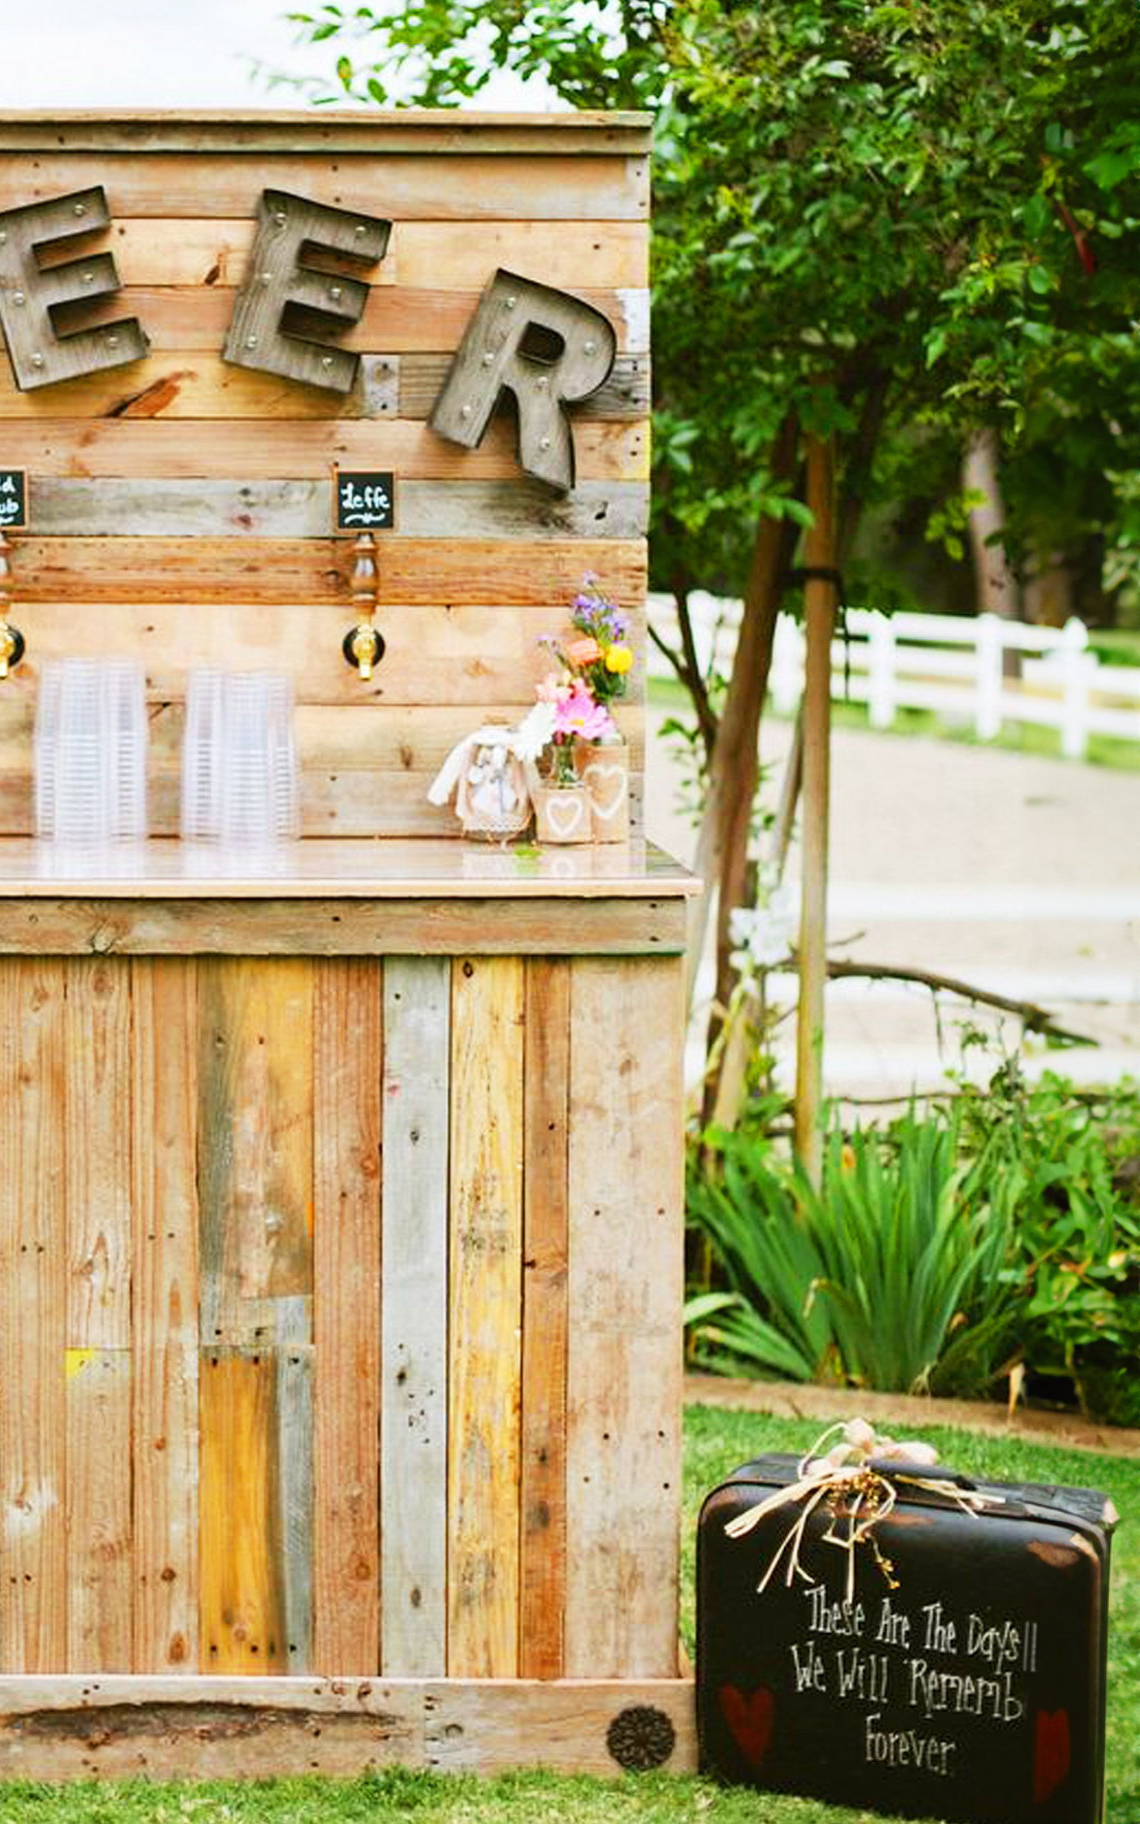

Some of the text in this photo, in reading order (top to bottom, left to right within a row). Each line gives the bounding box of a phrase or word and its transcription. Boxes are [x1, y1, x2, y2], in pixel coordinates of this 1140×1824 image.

[804, 1584, 865, 1636] These
[875, 1597, 911, 1649] Are
[922, 1601, 957, 1654] The
[790, 1641, 826, 1692] We
[837, 1647, 888, 1703] Will
[865, 1712, 957, 1775] Forever
